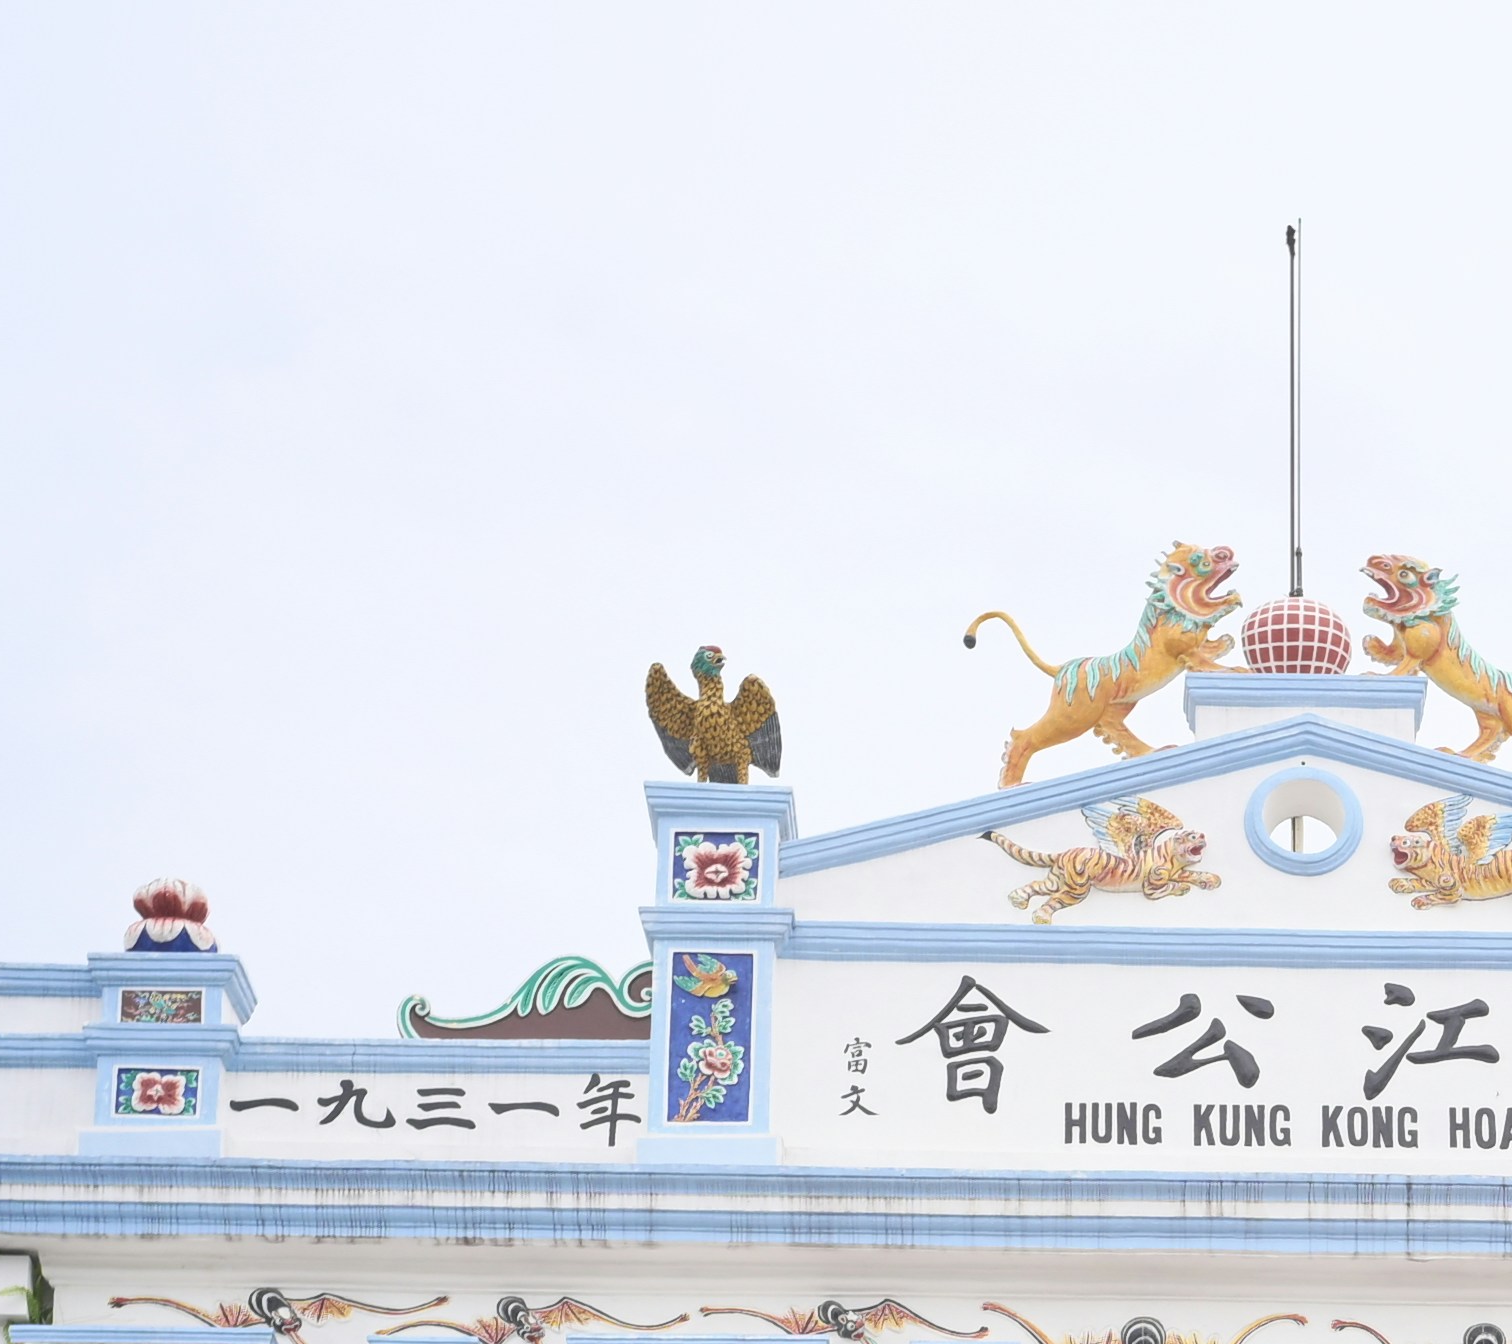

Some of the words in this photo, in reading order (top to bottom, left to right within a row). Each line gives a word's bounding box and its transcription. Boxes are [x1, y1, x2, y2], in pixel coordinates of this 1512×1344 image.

[228, 1071, 643, 1148] 一九三一年
[1063, 1102, 1163, 1146] HUNG
[1192, 1103, 1291, 1148] KUNG
[1320, 1105, 1419, 1149] KONG
